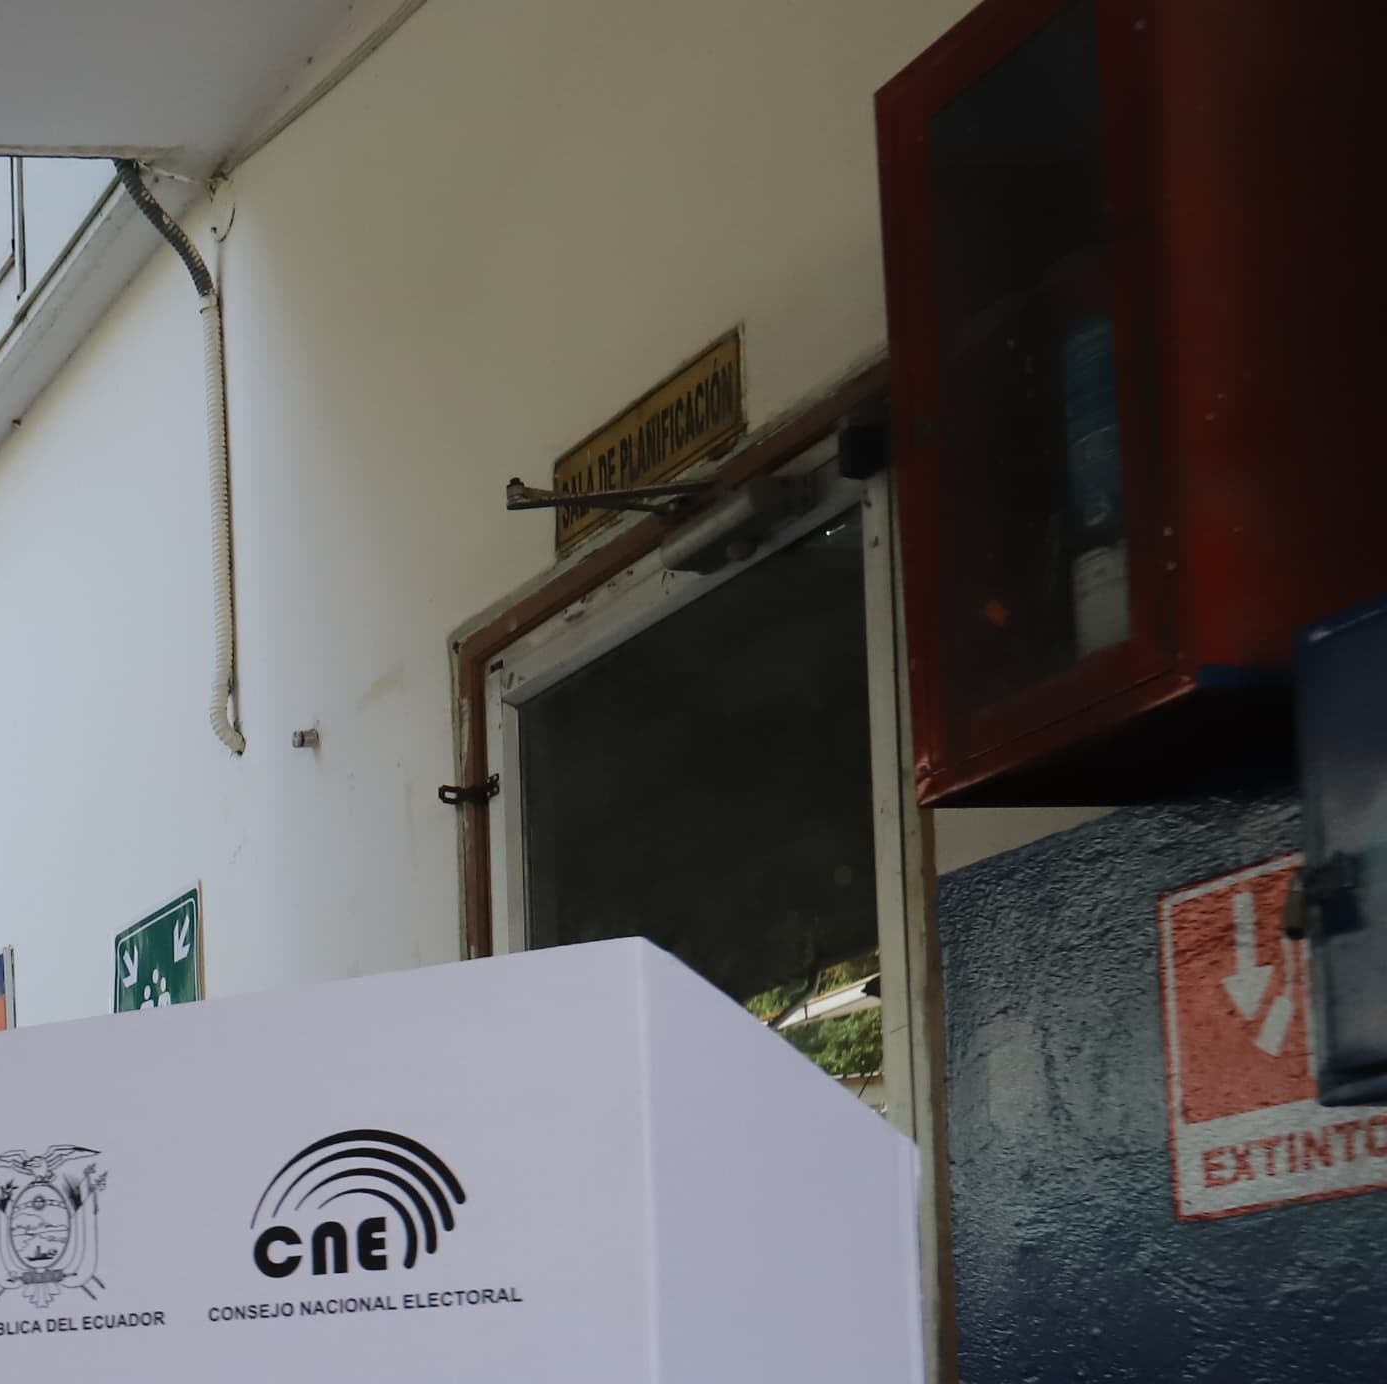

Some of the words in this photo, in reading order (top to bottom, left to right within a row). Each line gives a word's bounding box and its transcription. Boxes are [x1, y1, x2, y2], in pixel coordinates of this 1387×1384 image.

[598, 445, 616, 492] DE
[619, 358, 735, 489] PLANIFICACIÓN
[1202, 1114, 1387, 1188] EXTINTO
[254, 1216, 388, 1279] CNE
[46, 1317, 79, 1333] DEL
[82, 1310, 166, 1331] ECUADOR
[208, 1302, 294, 1322] CONSEJO
[300, 1295, 398, 1316] NACIONAL
[403, 1287, 524, 1309] ELECTORAL
